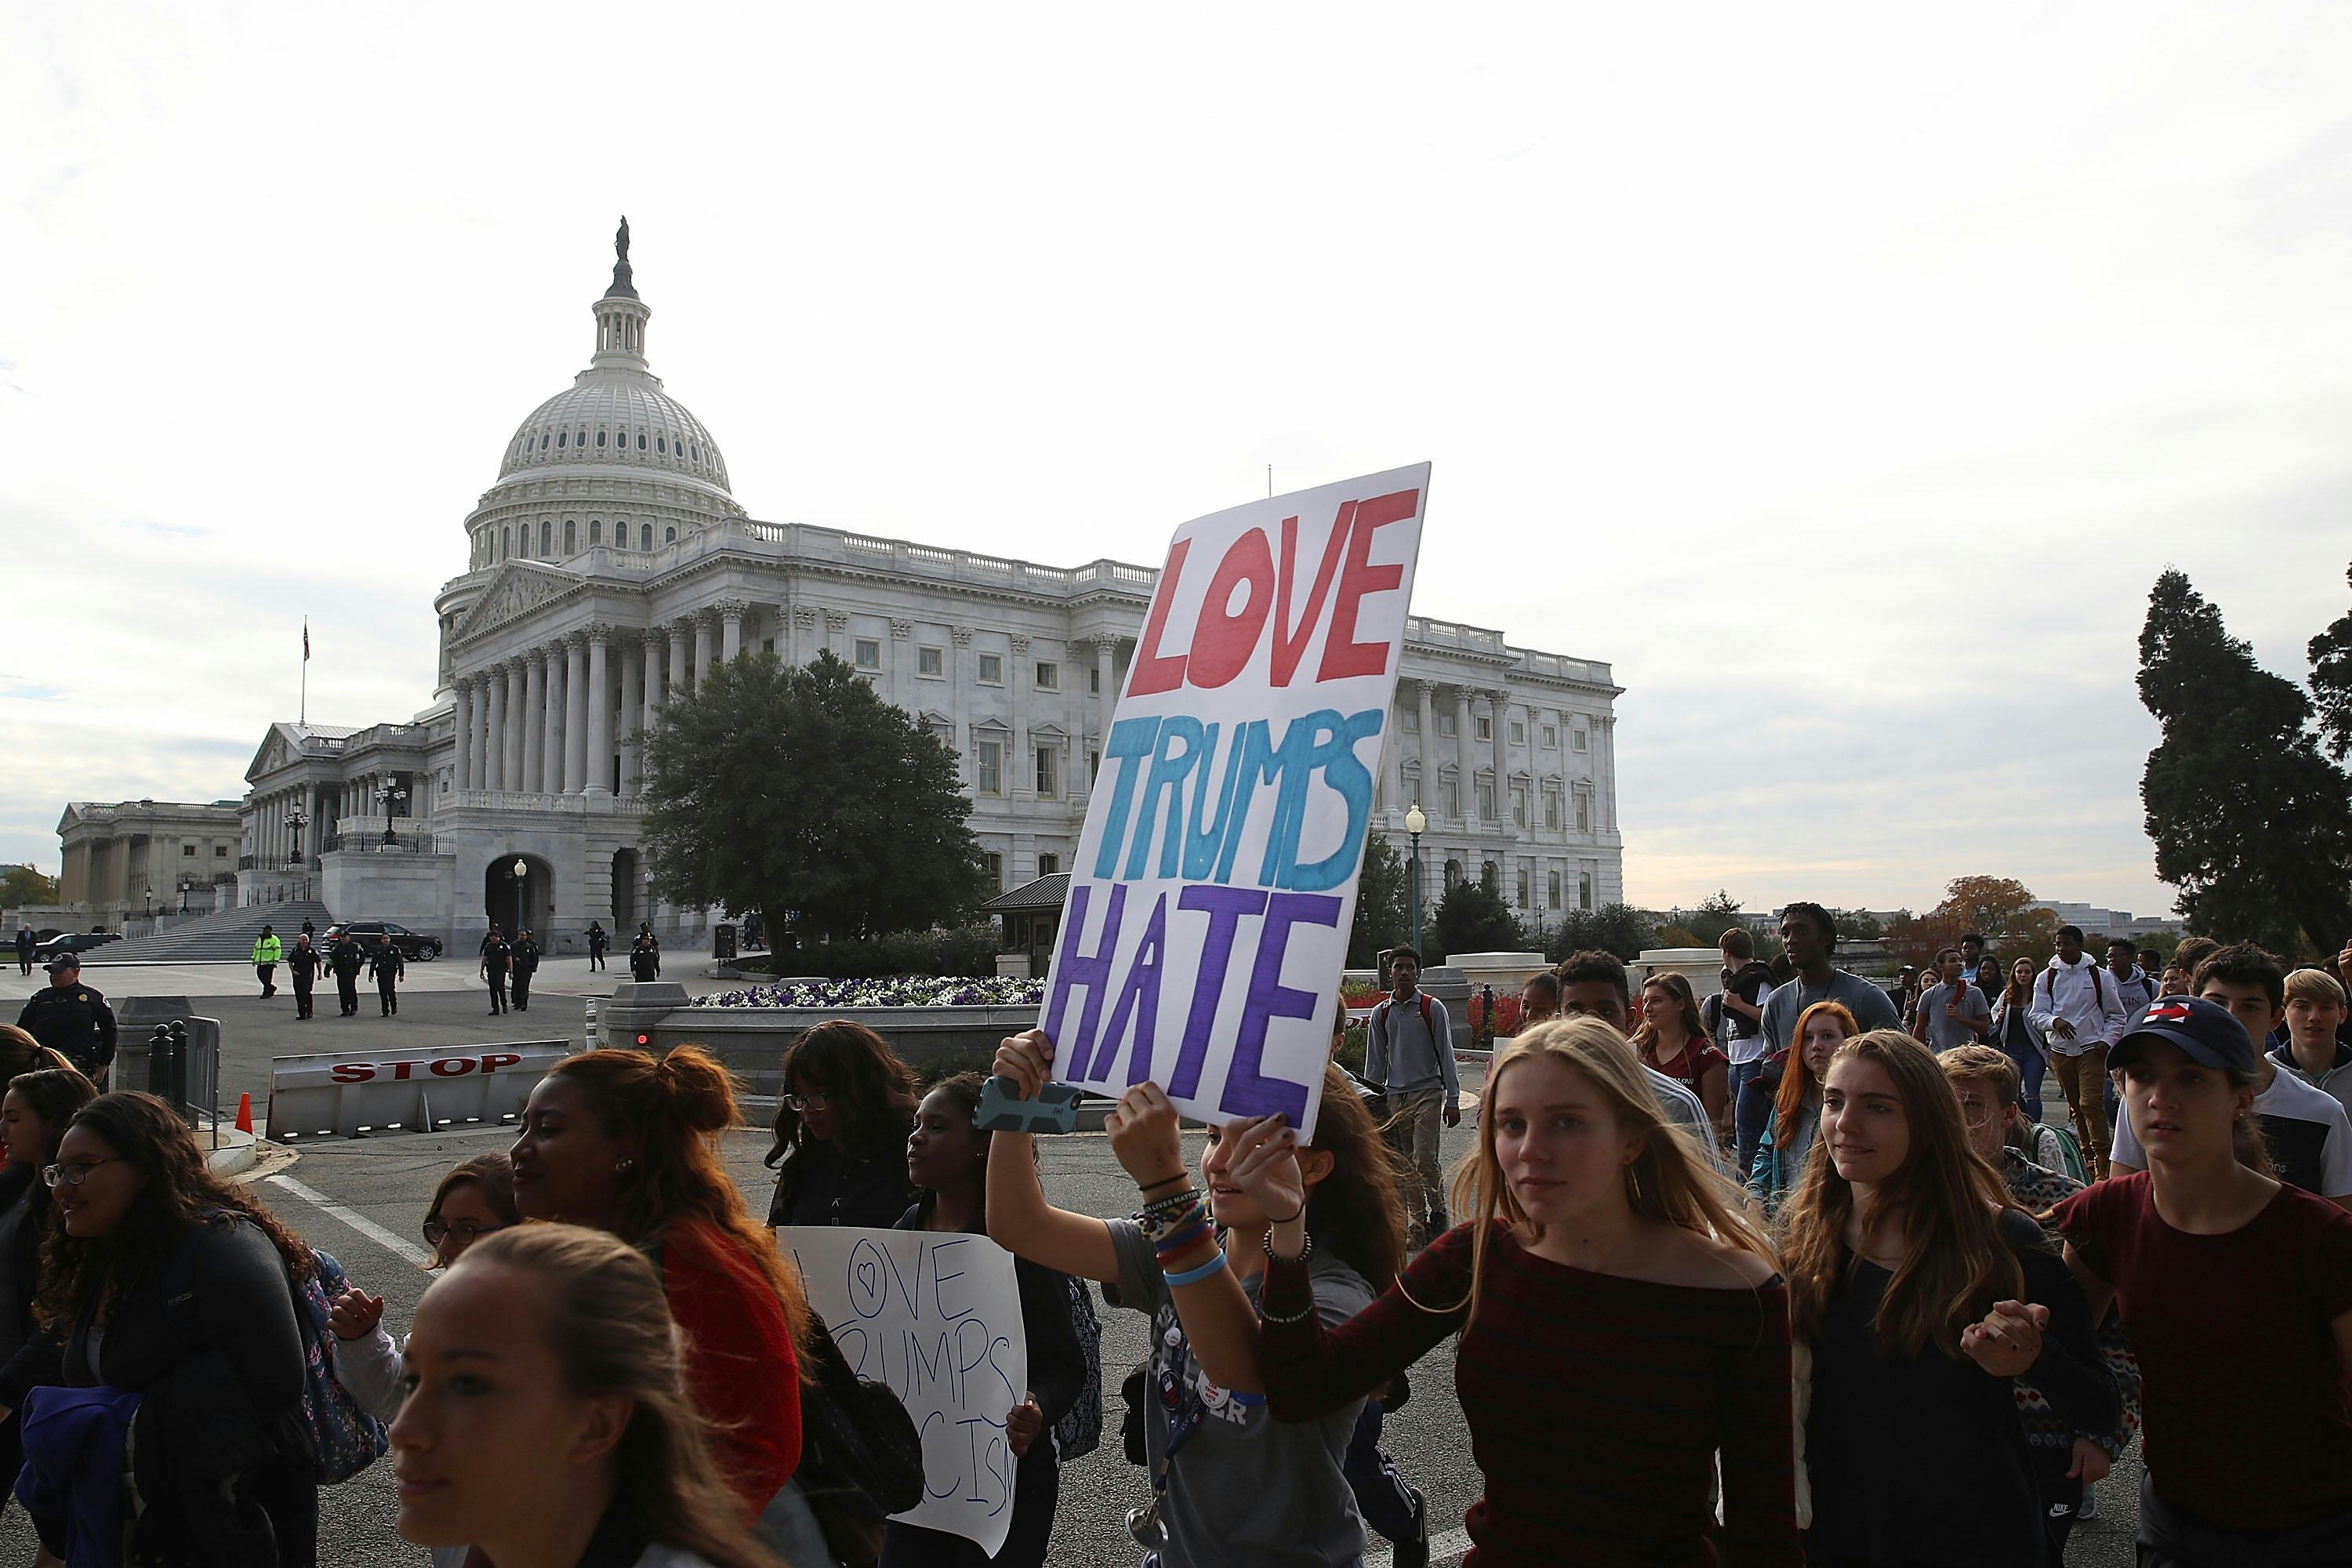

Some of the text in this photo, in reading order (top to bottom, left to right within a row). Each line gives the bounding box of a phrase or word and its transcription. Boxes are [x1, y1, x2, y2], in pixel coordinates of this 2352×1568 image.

[1127, 488, 1419, 698] LOVE
[1094, 708, 1384, 892] TRUMPS
[331, 1053, 521, 1083] STOP
[1044, 883, 1342, 1129] HATE
[2053, 1502, 2069, 1512] NIKE
